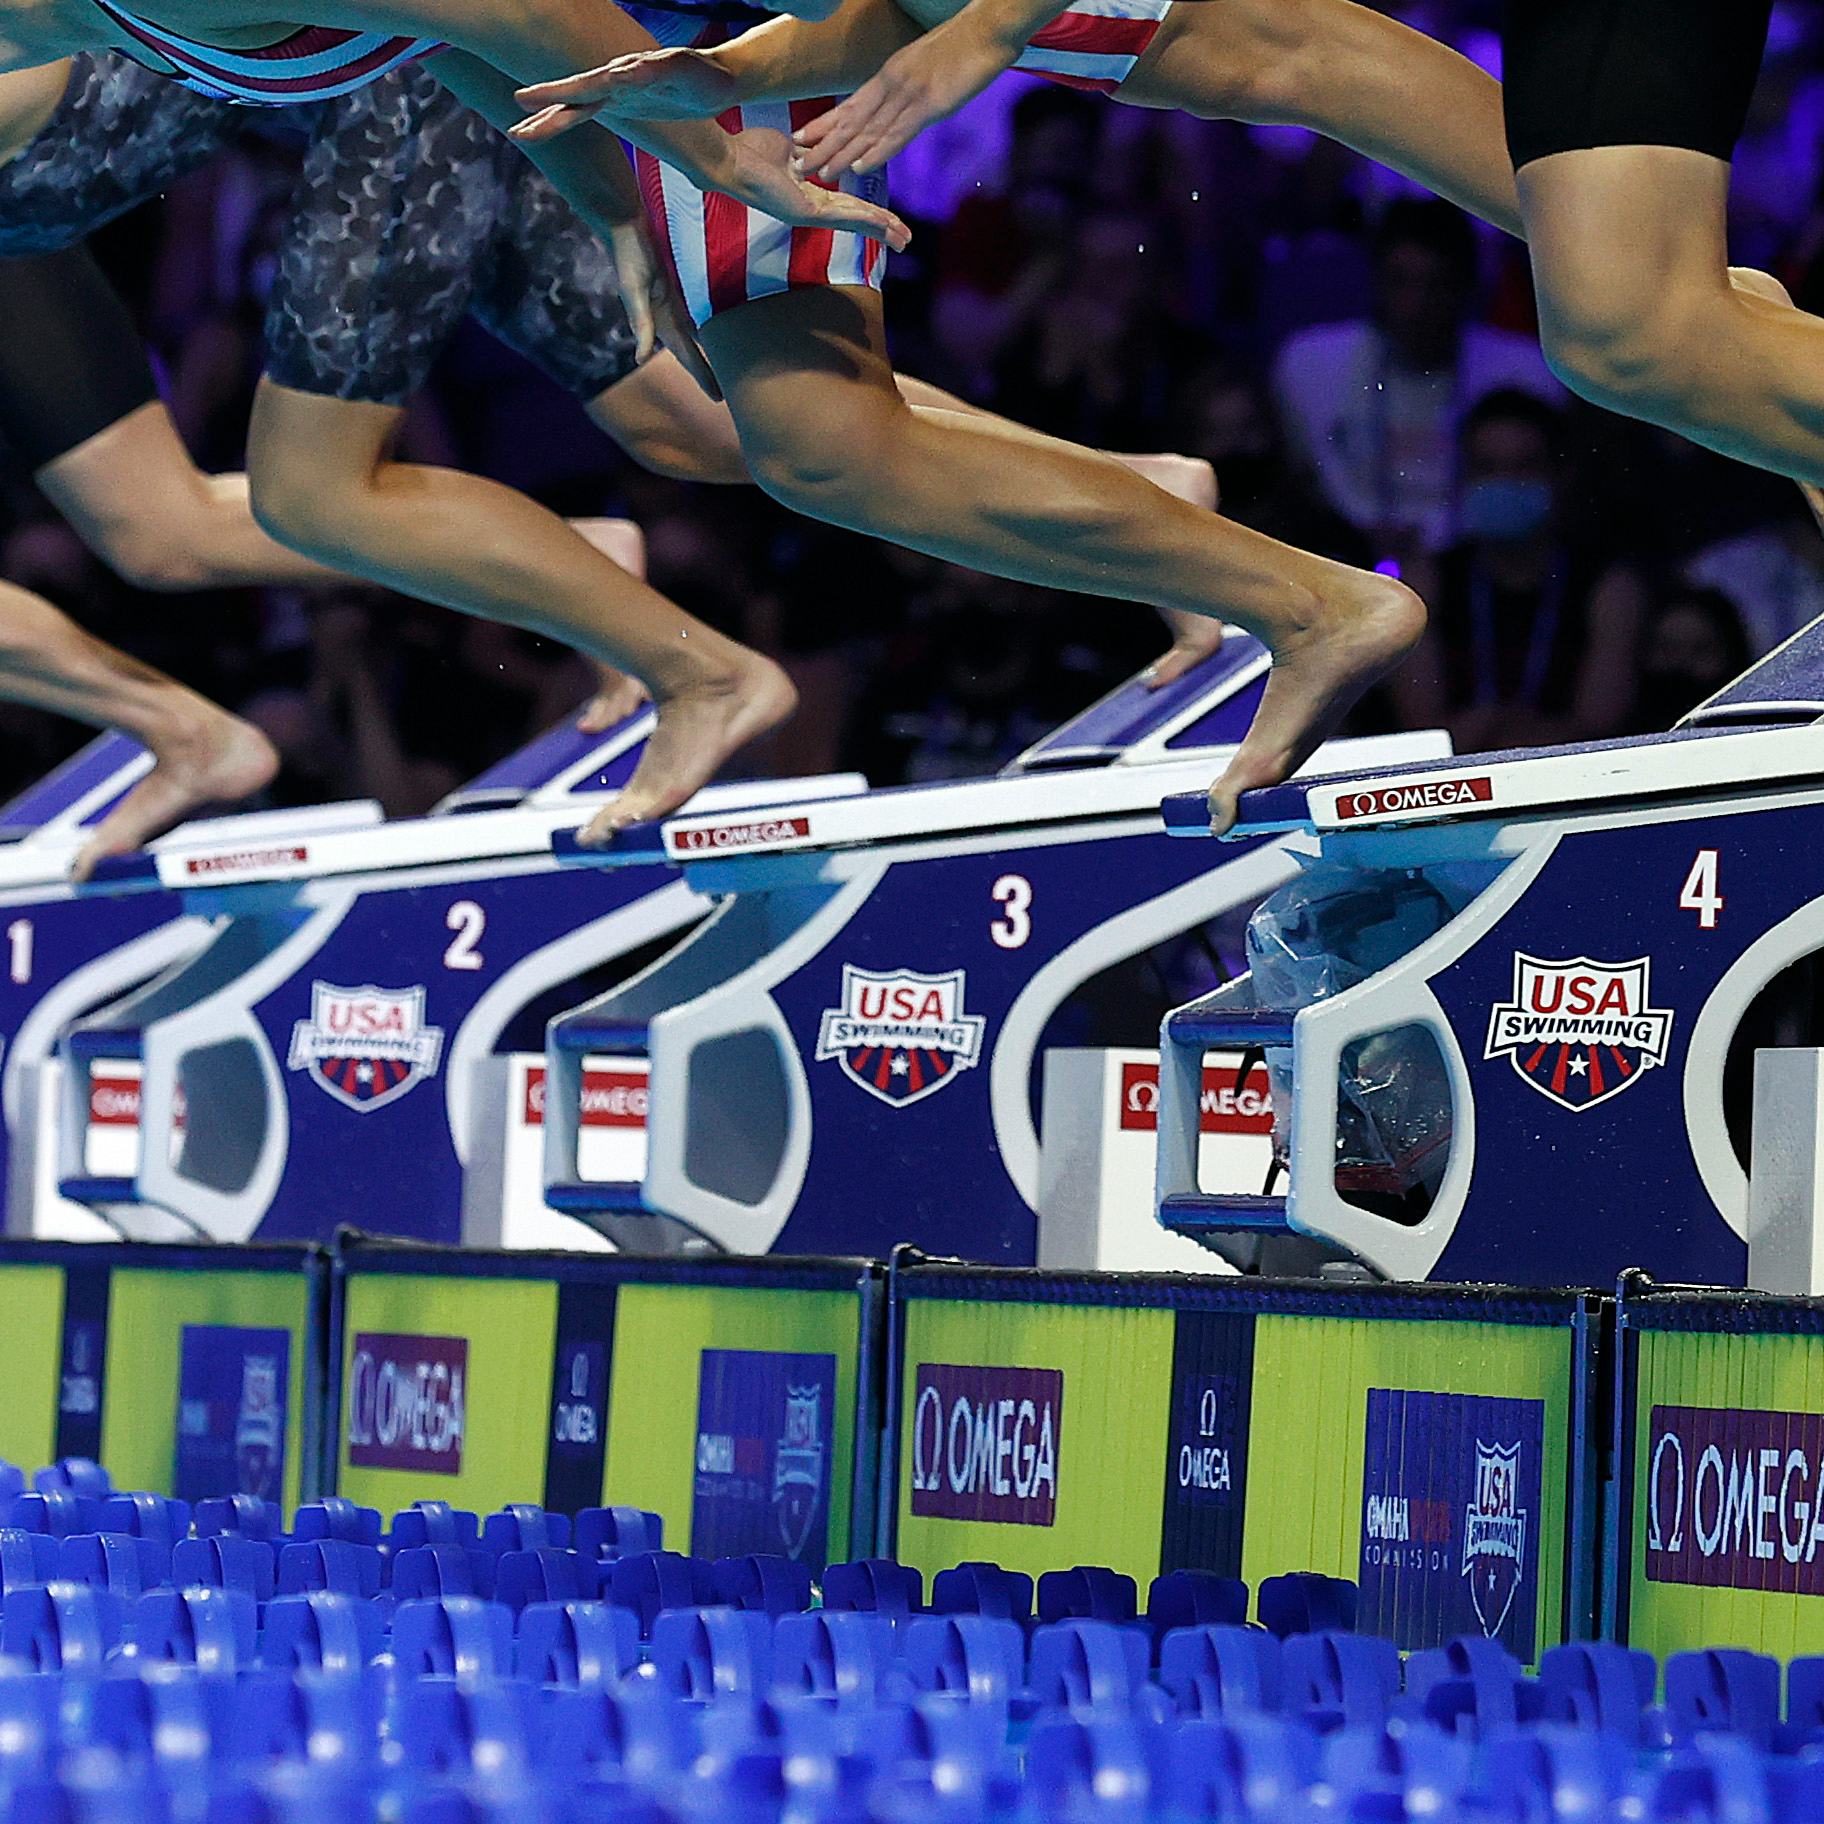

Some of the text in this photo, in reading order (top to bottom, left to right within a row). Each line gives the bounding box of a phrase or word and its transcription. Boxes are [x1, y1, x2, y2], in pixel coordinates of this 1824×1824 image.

[1382, 781, 1477, 811] OMEGA
[713, 821, 798, 847] OMEGA
[1679, 848, 1724, 930] 4
[990, 874, 1033, 949] 3
[7, 918, 34, 986] 1
[443, 900, 485, 970] 2
[860, 987, 946, 1021] USA
[1531, 975, 1629, 1016] USA
[329, 1002, 404, 1035] USA
[834, 1023, 966, 1046] SWIMMING
[1504, 1015, 1653, 1043] SWIMMING
[948, 1396, 1056, 1500] OMEGA
[1179, 1444, 1231, 1491] OMEGA
[1478, 1465, 1512, 1518] USA
